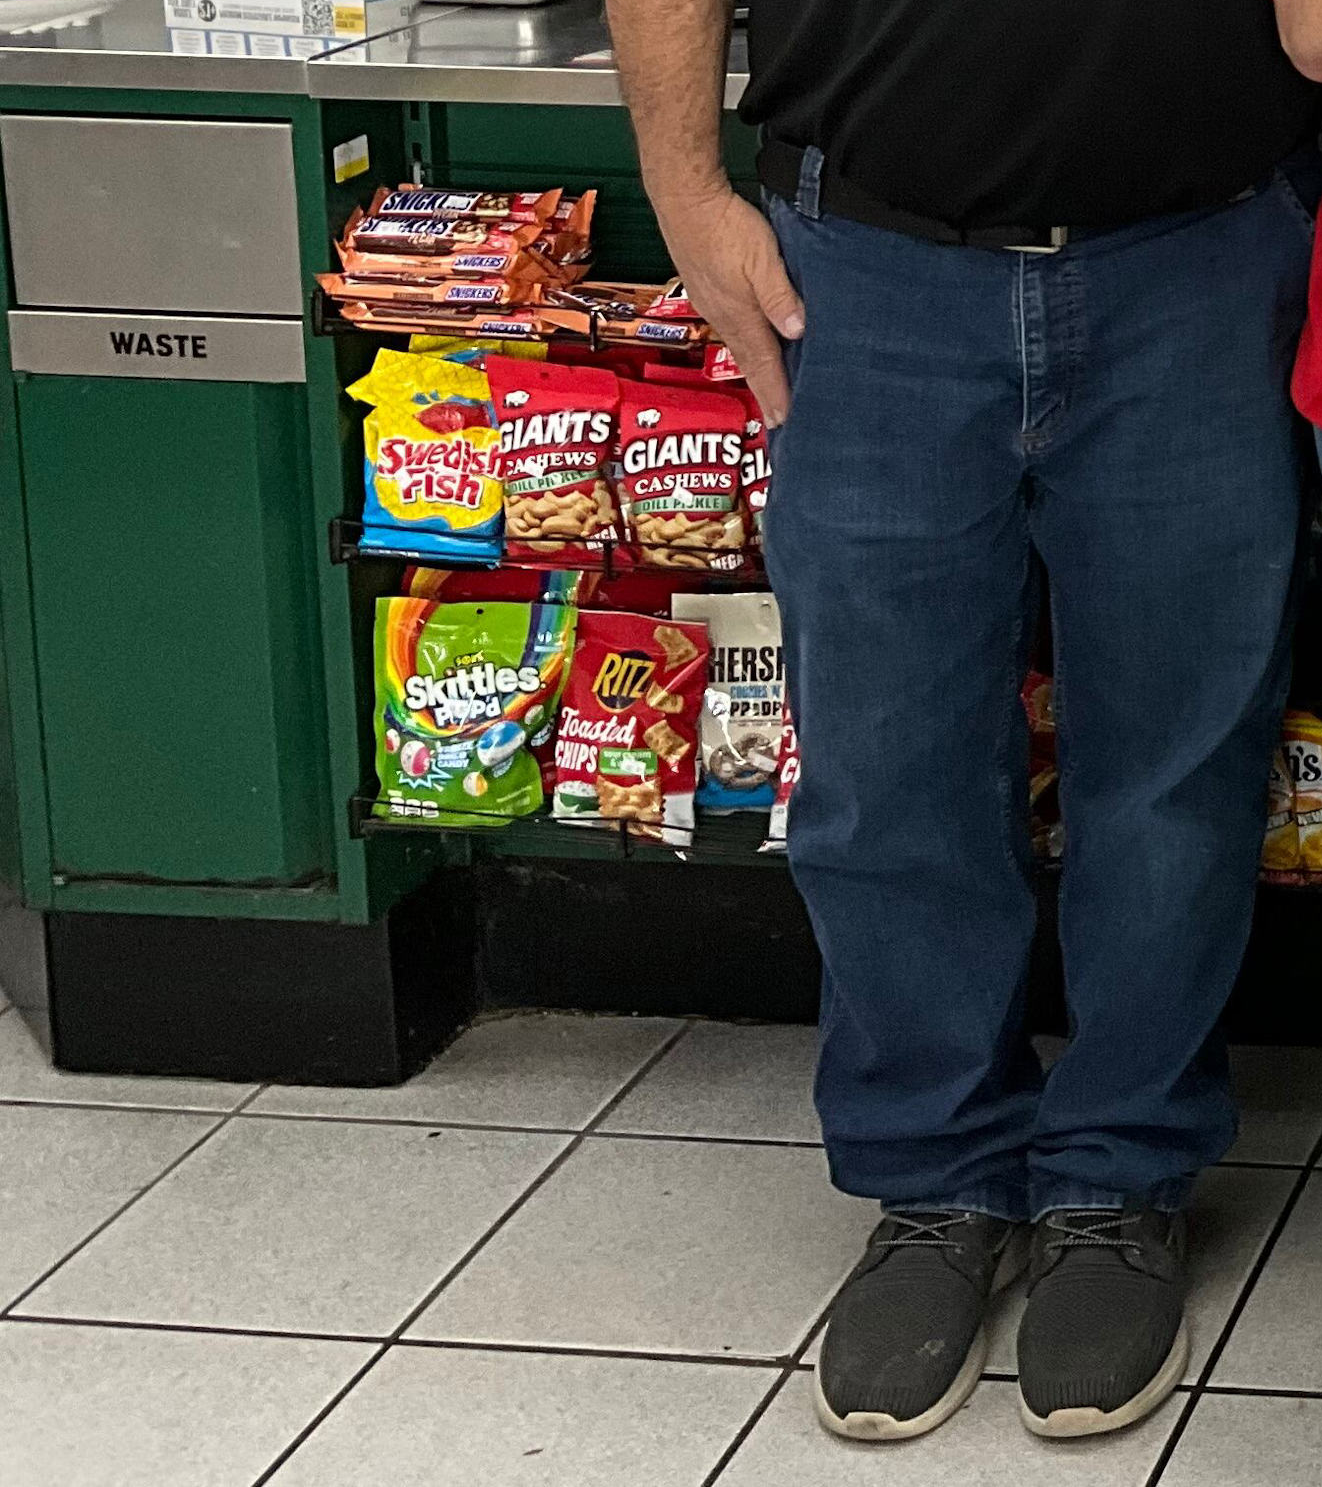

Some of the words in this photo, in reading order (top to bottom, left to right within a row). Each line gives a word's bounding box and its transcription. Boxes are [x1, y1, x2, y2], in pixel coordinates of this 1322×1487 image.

[455, 256, 504, 269] SNICKERS
[447, 287, 496, 300] SNICKERS
[110, 331, 208, 359] WASTE
[637, 325, 685, 340] SNICKERS
[500, 411, 612, 452] GIANTS
[377, 438, 505, 478] Swedish
[624, 433, 743, 474] GIANTS
[400, 467, 483, 509] Fish
[634, 473, 732, 495] CASHEWS
[643, 499, 668, 511] DILL
[405, 664, 541, 711] Skittles
[593, 649, 658, 709] RITZ
[558, 705, 635, 748] Toasted
[555, 743, 598, 773] CHIPS
